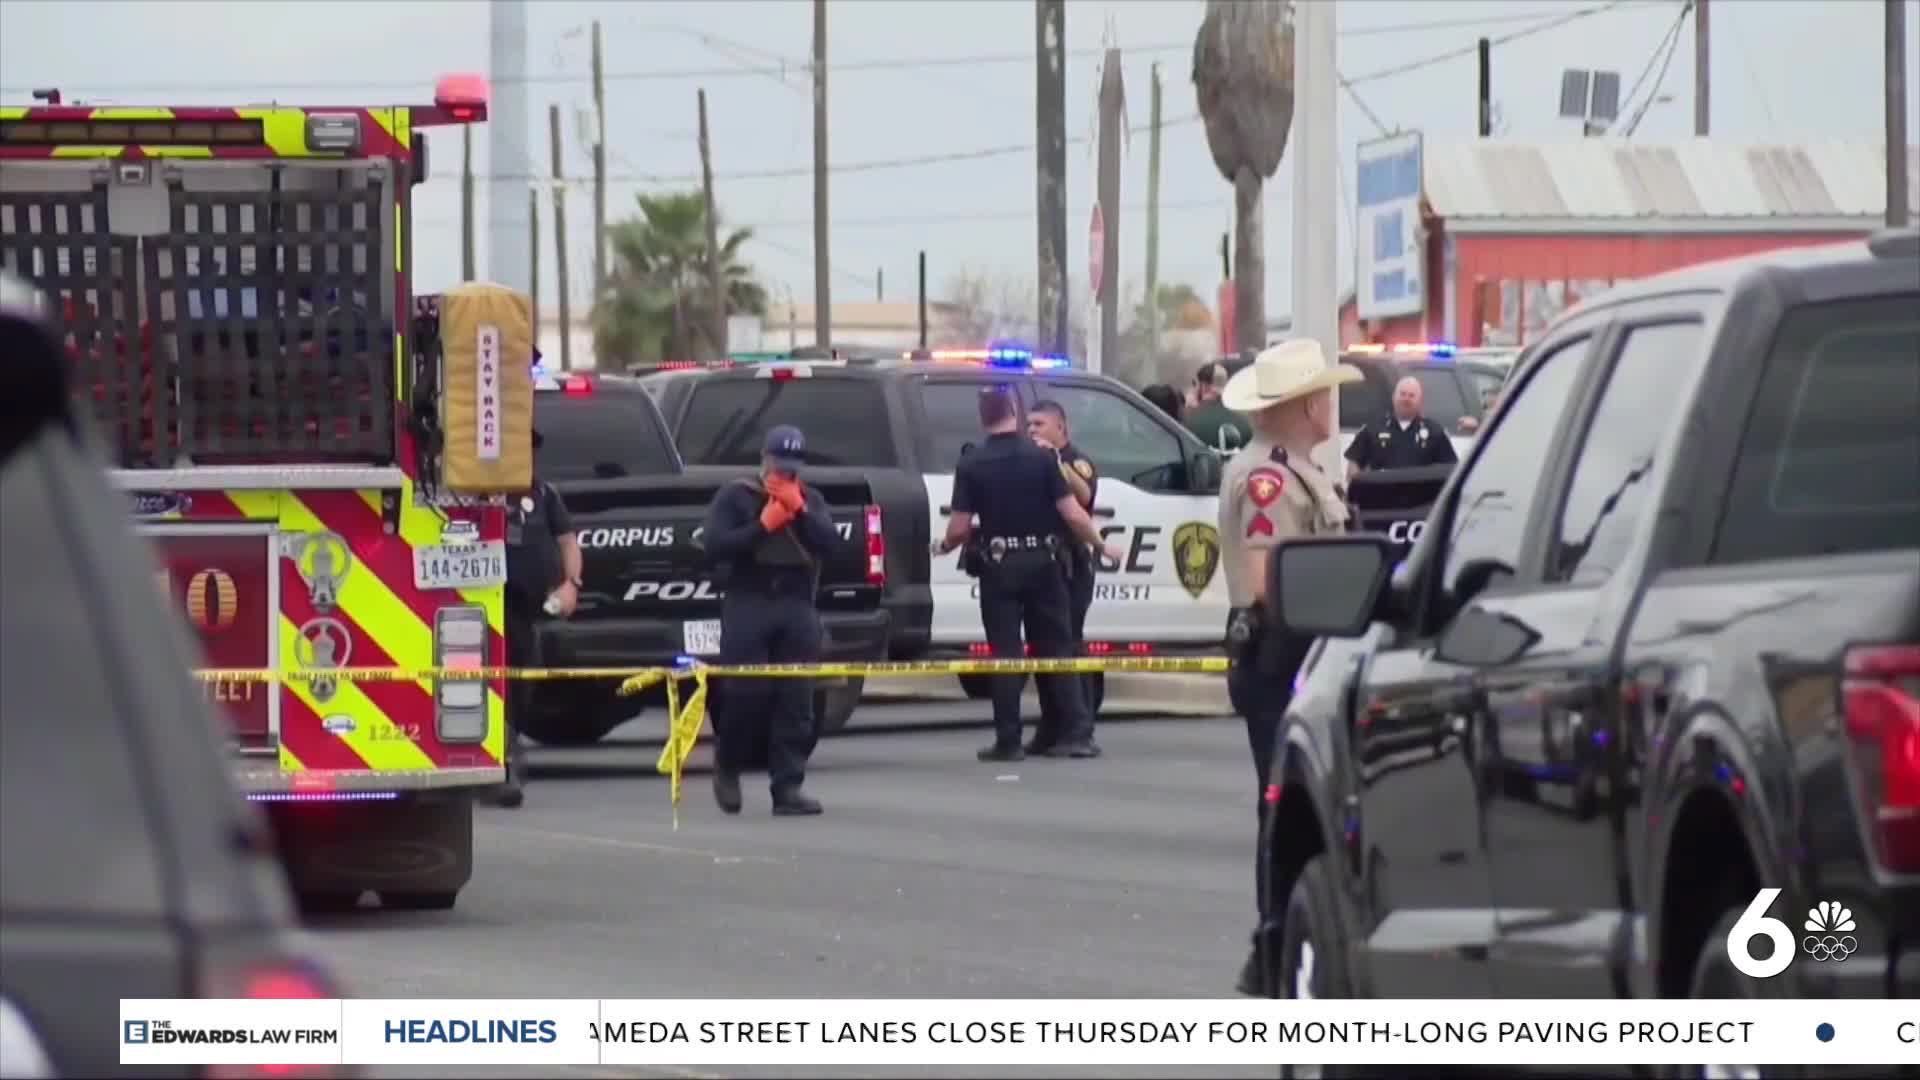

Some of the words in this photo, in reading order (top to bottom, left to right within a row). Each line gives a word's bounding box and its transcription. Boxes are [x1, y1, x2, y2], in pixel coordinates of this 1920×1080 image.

[482, 335, 493, 387] STAY
[483, 395, 494, 447] BACK
[577, 527, 674, 547] CORPUS
[1389, 520, 1425, 544] CO
[623, 581, 726, 600] POL
[1096, 584, 1150, 599] RISTI
